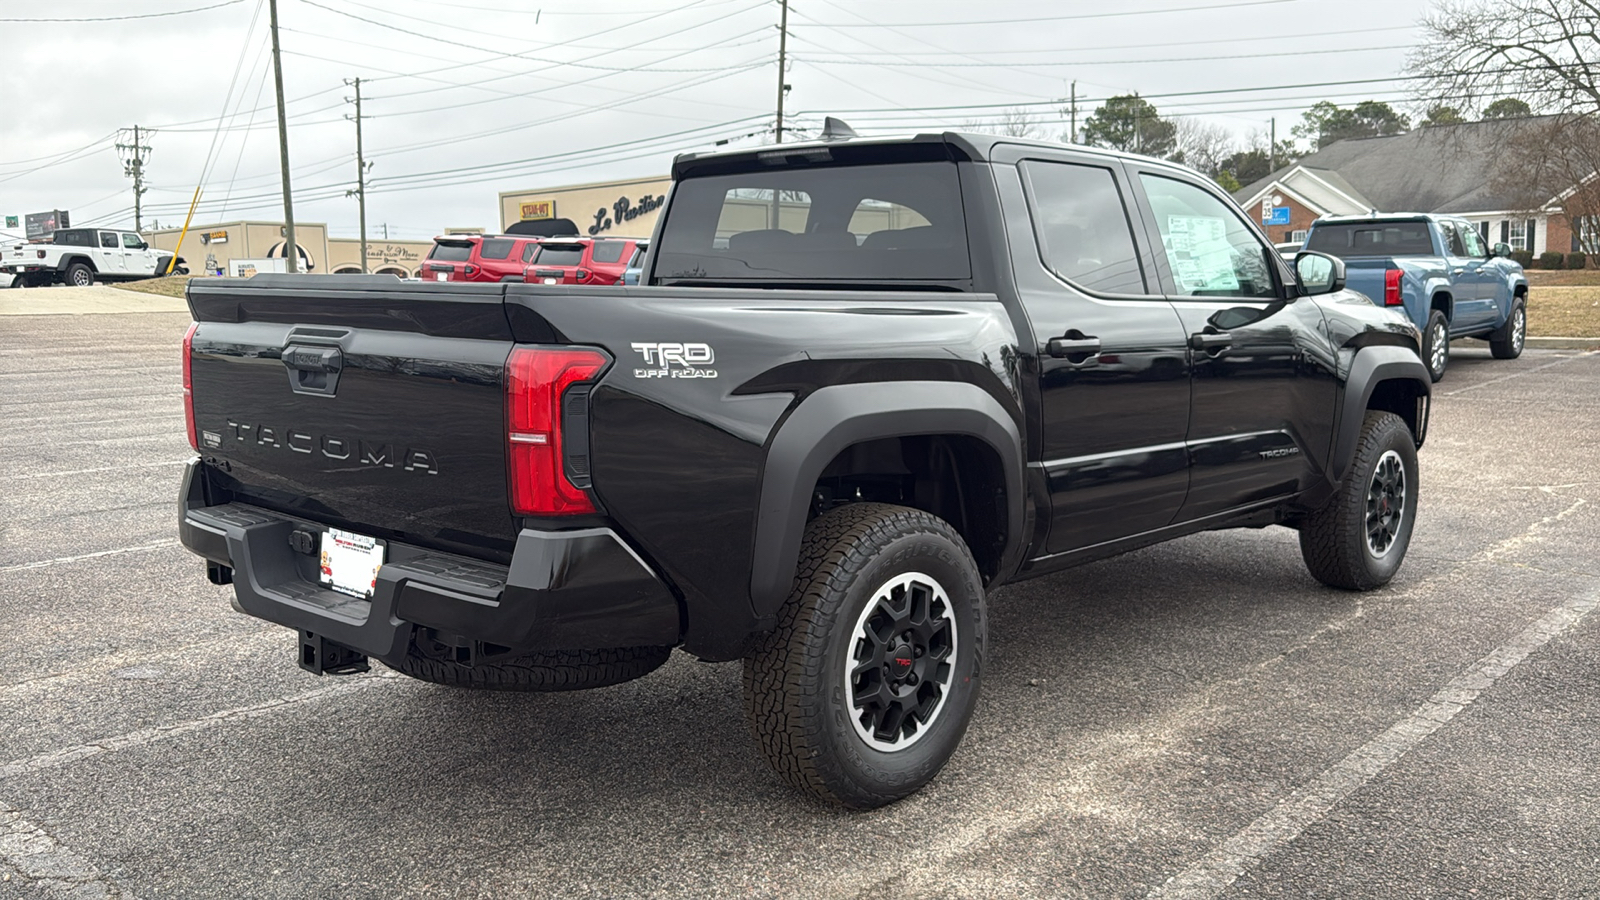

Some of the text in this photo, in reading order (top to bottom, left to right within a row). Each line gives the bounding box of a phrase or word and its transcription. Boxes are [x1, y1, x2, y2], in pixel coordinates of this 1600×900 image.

[588, 194, 665, 235] Le Pavilion
[1263, 207, 1271, 217] 35
[295, 353, 323, 366] TOYOTA
[630, 342, 715, 370] TRD
[633, 368, 718, 379] OFF ROAD
[227, 418, 439, 475] TACOMA
[1259, 447, 1298, 459] TACOMA
[895, 657, 911, 667] TRD
